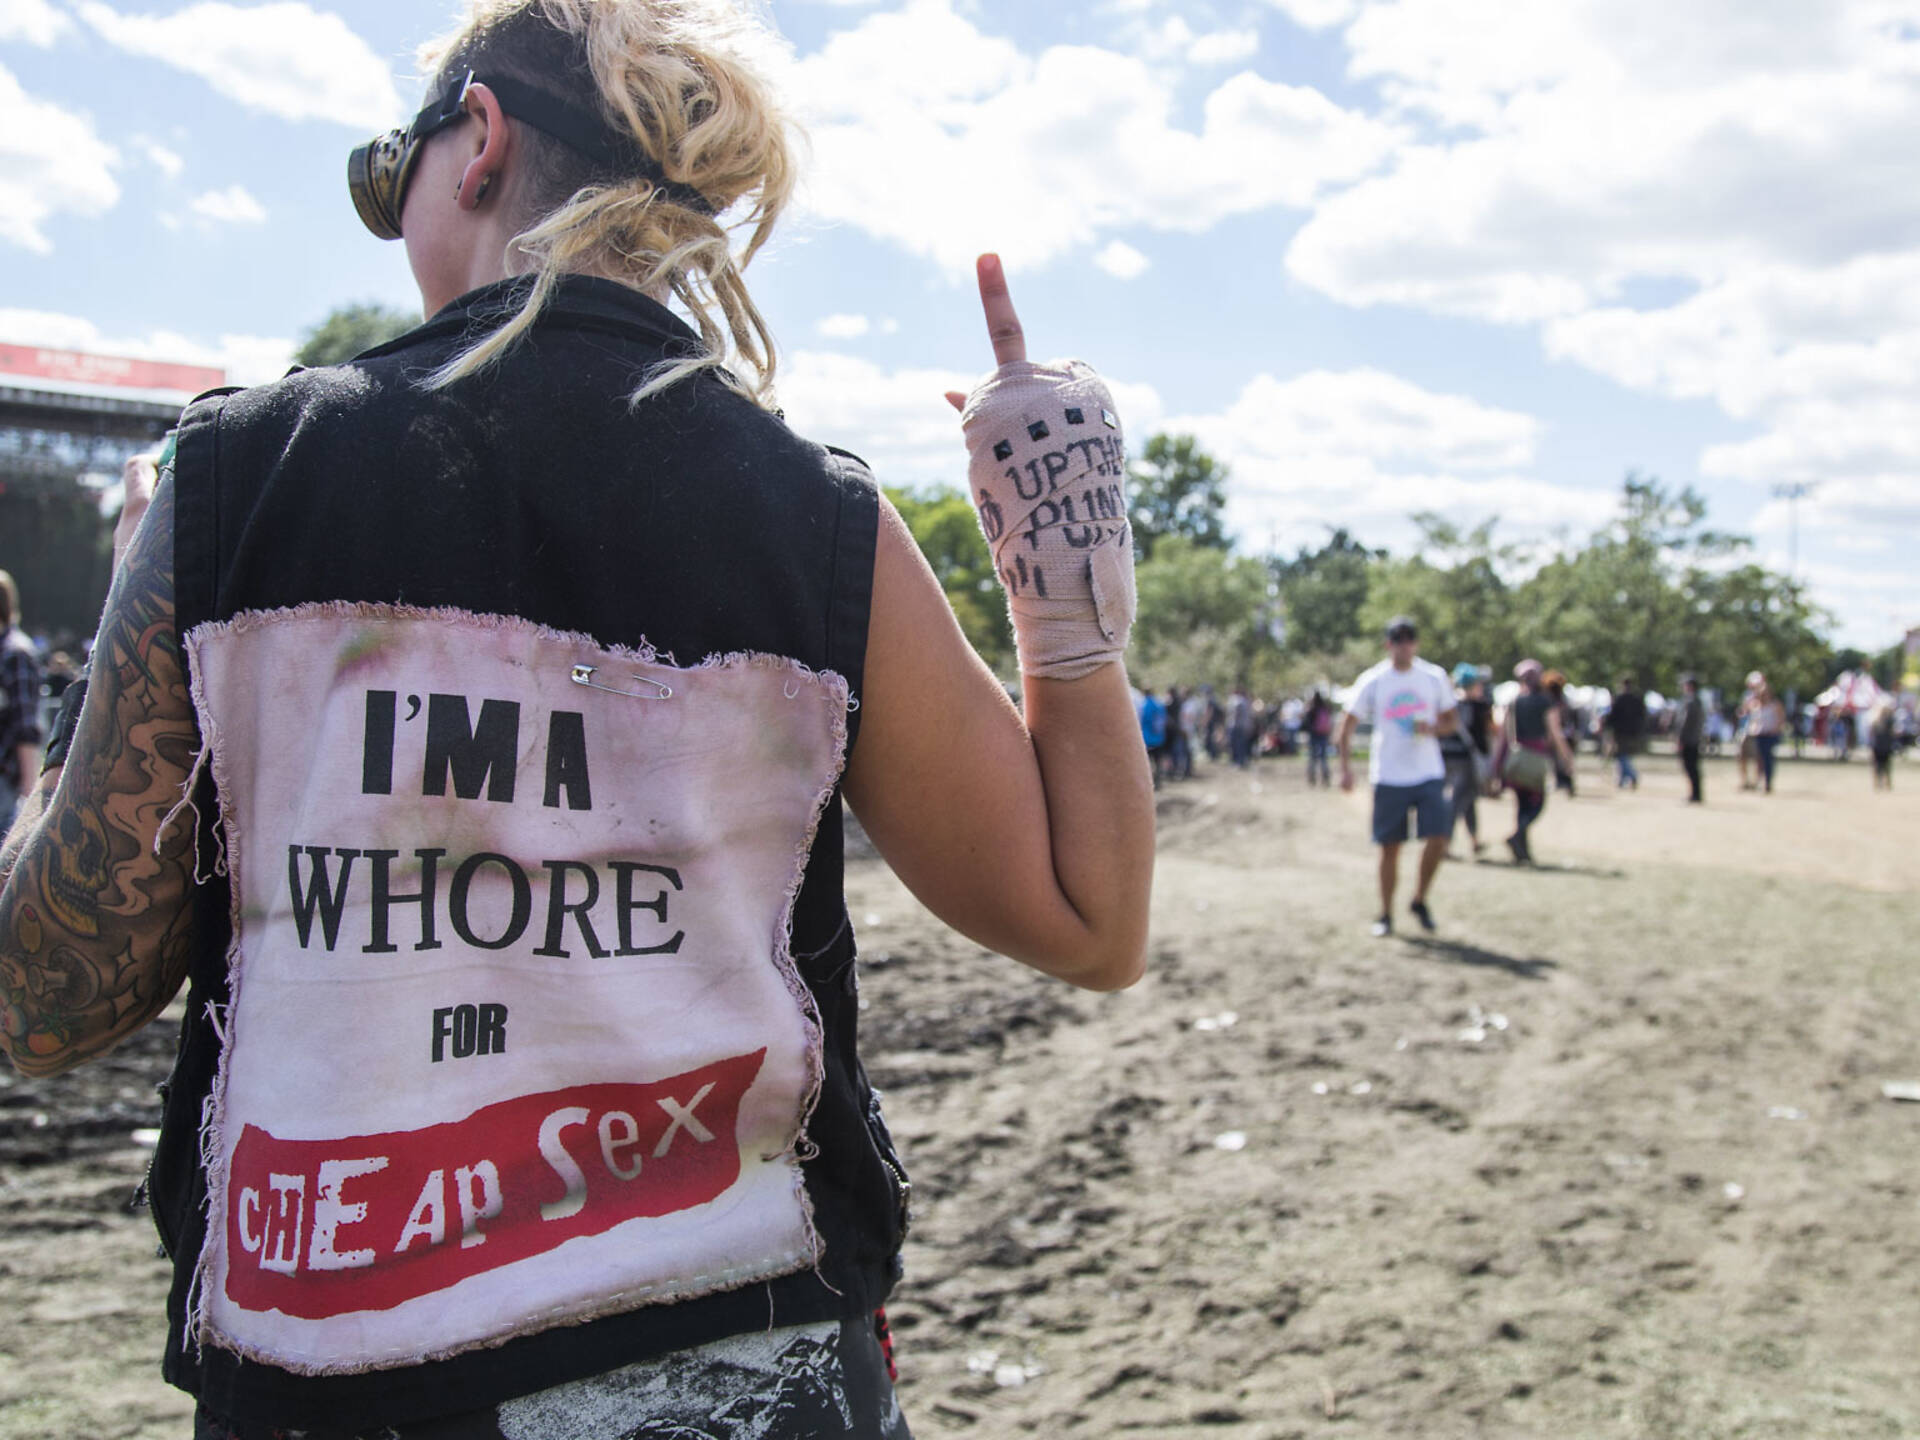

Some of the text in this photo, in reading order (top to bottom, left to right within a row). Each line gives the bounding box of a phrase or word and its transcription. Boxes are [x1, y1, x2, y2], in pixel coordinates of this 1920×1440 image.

[1005, 451, 1069, 500] UP
[361, 690, 592, 810] I'M A
[288, 844, 685, 959] WHORE
[431, 1003, 507, 1062] FOR
